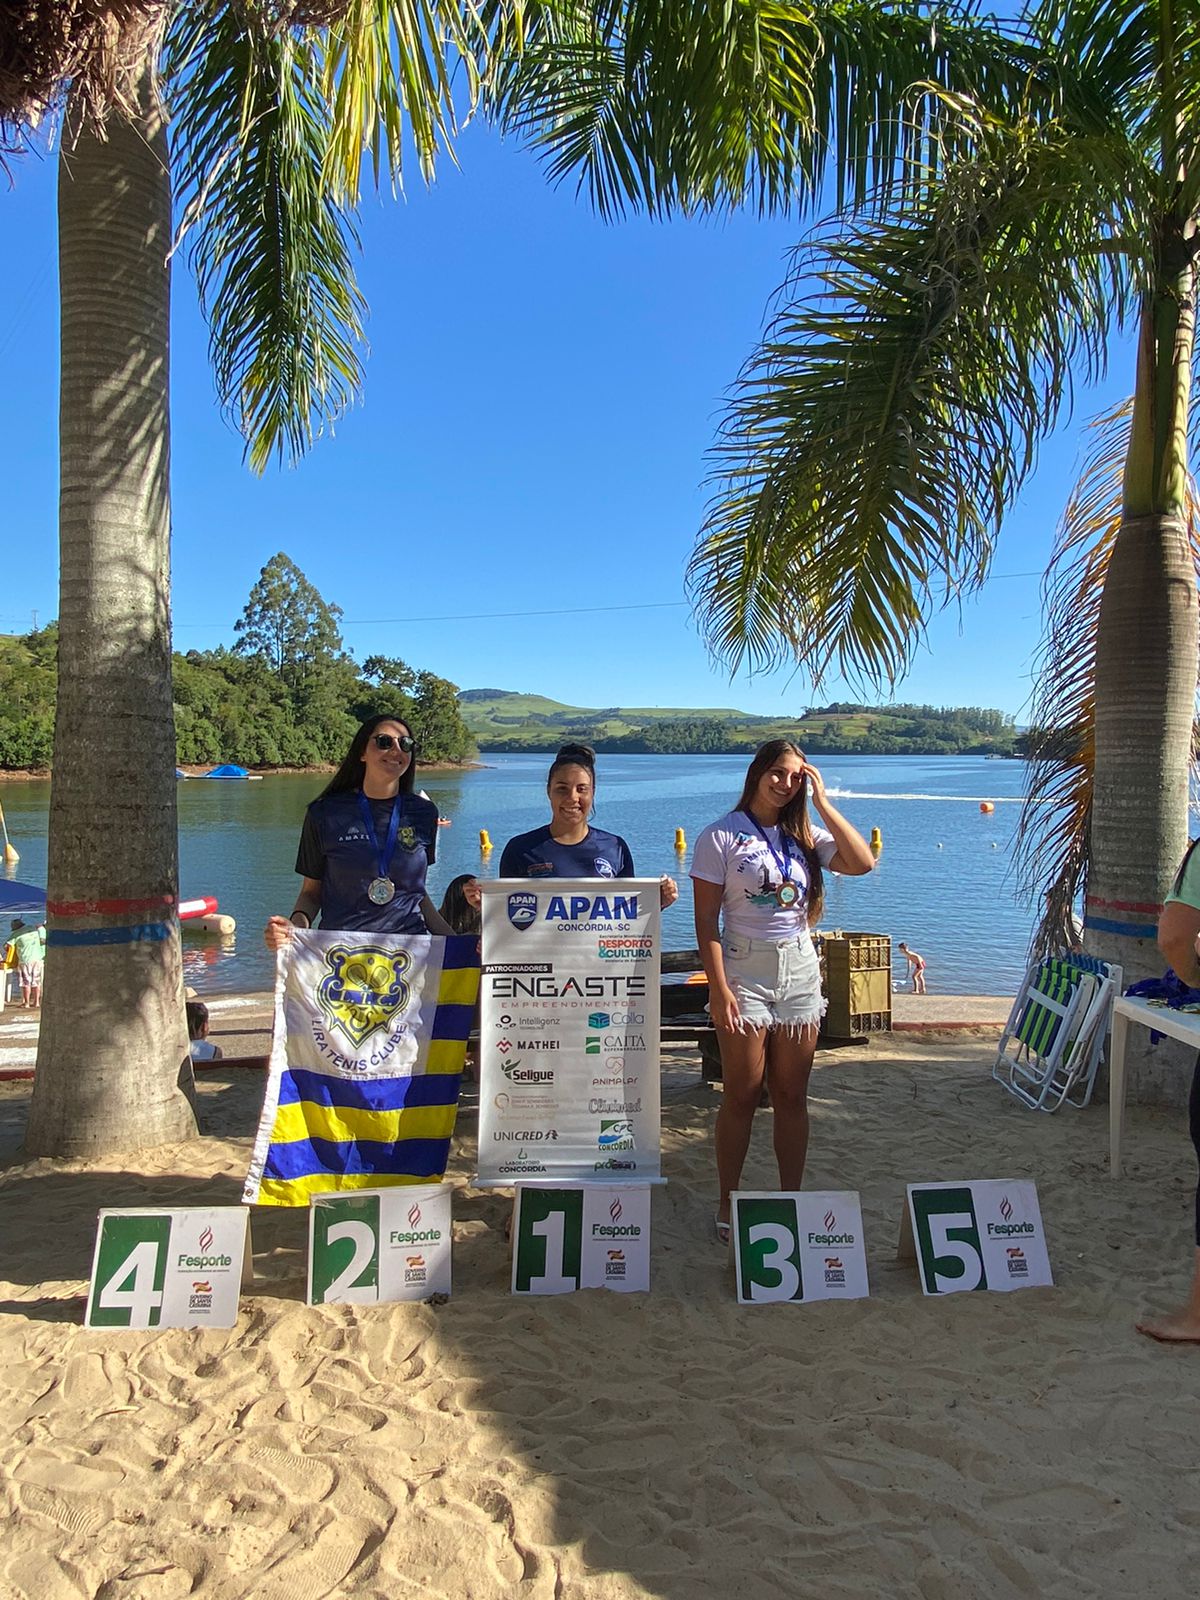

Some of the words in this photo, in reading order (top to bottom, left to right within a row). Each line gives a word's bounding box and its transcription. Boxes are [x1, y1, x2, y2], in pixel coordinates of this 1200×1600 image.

[509, 896, 536, 904] APAN
[545, 896, 638, 920] APAN
[557, 922, 613, 932] CONCÓRDIA
[598, 939, 653, 948] DESPORTO
[485, 965, 549, 973] PATROCINADORES
[492, 976, 646, 998] ENGASTE
[501, 1000, 637, 1009] EMPREENDIMENTOS
[519, 1017, 561, 1027] Intelligenz
[611, 1012, 645, 1025] Colla
[312, 1020, 328, 1052] LIRA
[327, 1049, 367, 1071] TÊNIS
[370, 1024, 408, 1066] CLUBE
[517, 1041, 560, 1050] MATHEI
[604, 1033, 646, 1047] CAITÁ
[513, 1069, 554, 1082] Seligue
[493, 1130, 543, 1141] UNICRED
[592, 1223, 641, 1238] Fesporte
[987, 1221, 1035, 1236] Fesporte
[390, 1228, 441, 1244] Fesporte
[808, 1232, 855, 1246] Fesporte
[530, 1211, 577, 1292] 1
[927, 1212, 984, 1291] 5
[178, 1254, 232, 1269] Fesporte
[324, 1220, 378, 1303] 2
[749, 1222, 800, 1302] 3
[100, 1241, 163, 1327] 4
